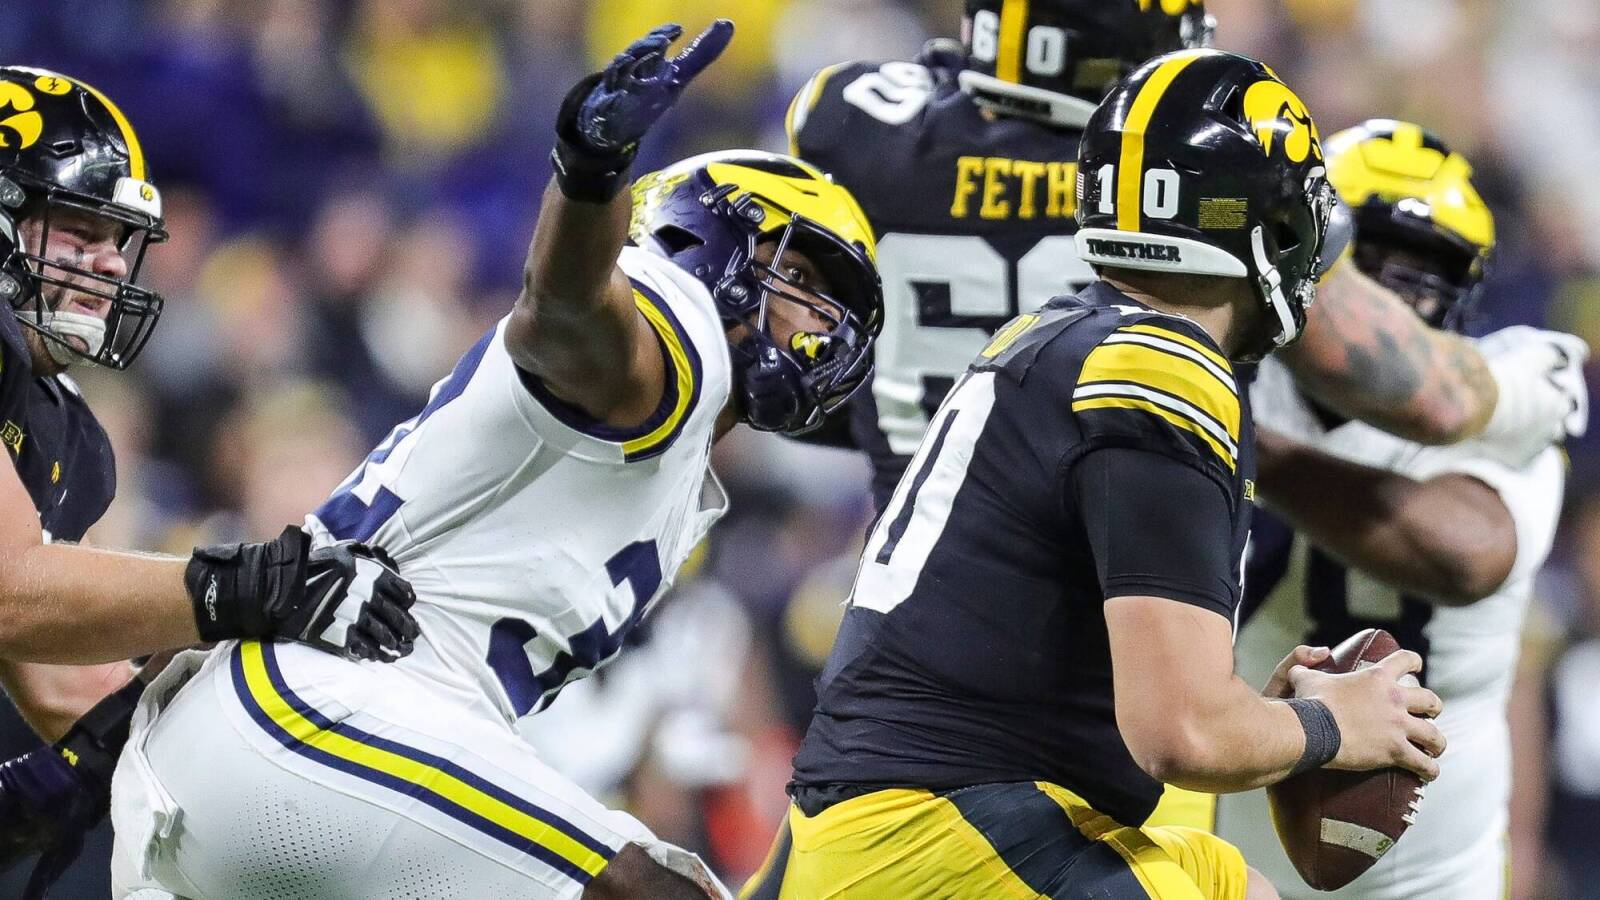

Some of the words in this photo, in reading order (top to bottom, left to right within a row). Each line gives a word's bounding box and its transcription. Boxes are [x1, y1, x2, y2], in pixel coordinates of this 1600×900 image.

[950, 156, 1077, 218] FETH
[1098, 163, 1180, 219] 10
[1086, 238, 1181, 262] TOGETHER
